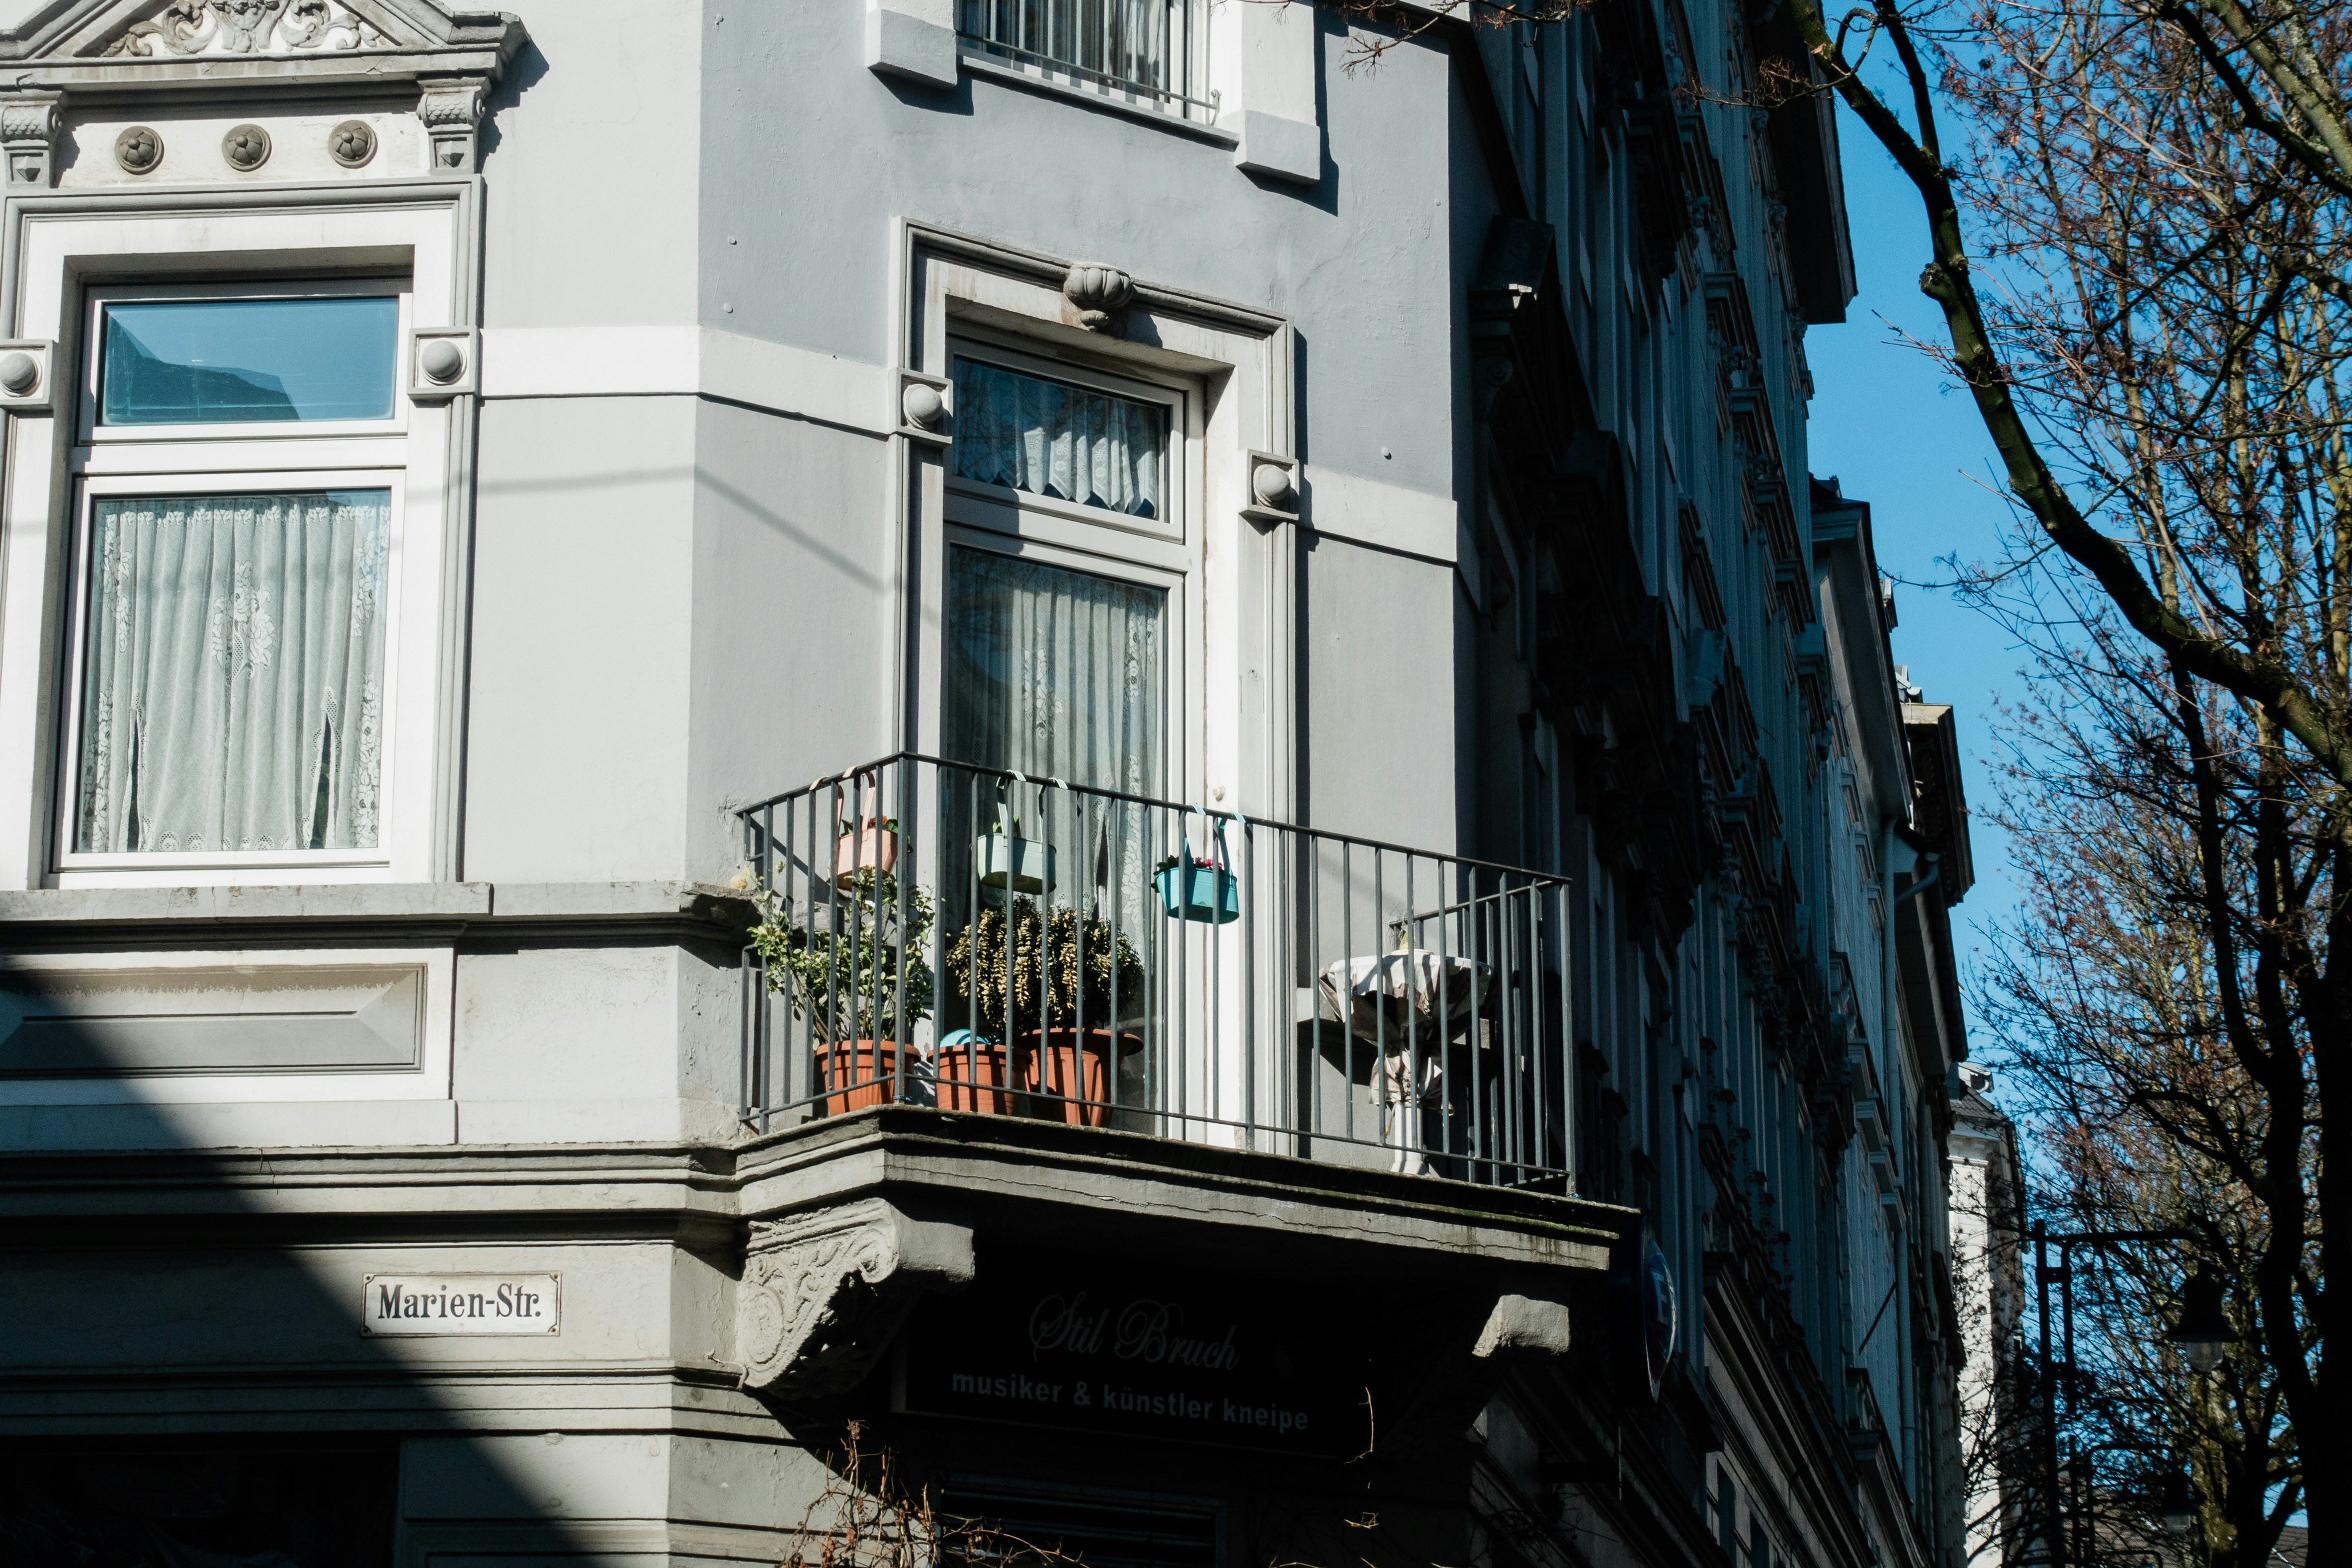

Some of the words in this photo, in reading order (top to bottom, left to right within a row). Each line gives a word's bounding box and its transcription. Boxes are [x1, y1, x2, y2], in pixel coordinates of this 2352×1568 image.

[378, 1283, 542, 1319] Marien-Str.
[1028, 1291, 1109, 1362] Stil
[1114, 1298, 1241, 1371] Bruch
[951, 1372, 1063, 1403] musiker
[1073, 1381, 1092, 1406] &
[1103, 1384, 1212, 1420] künstler
[1223, 1398, 1309, 1434] kneipe
